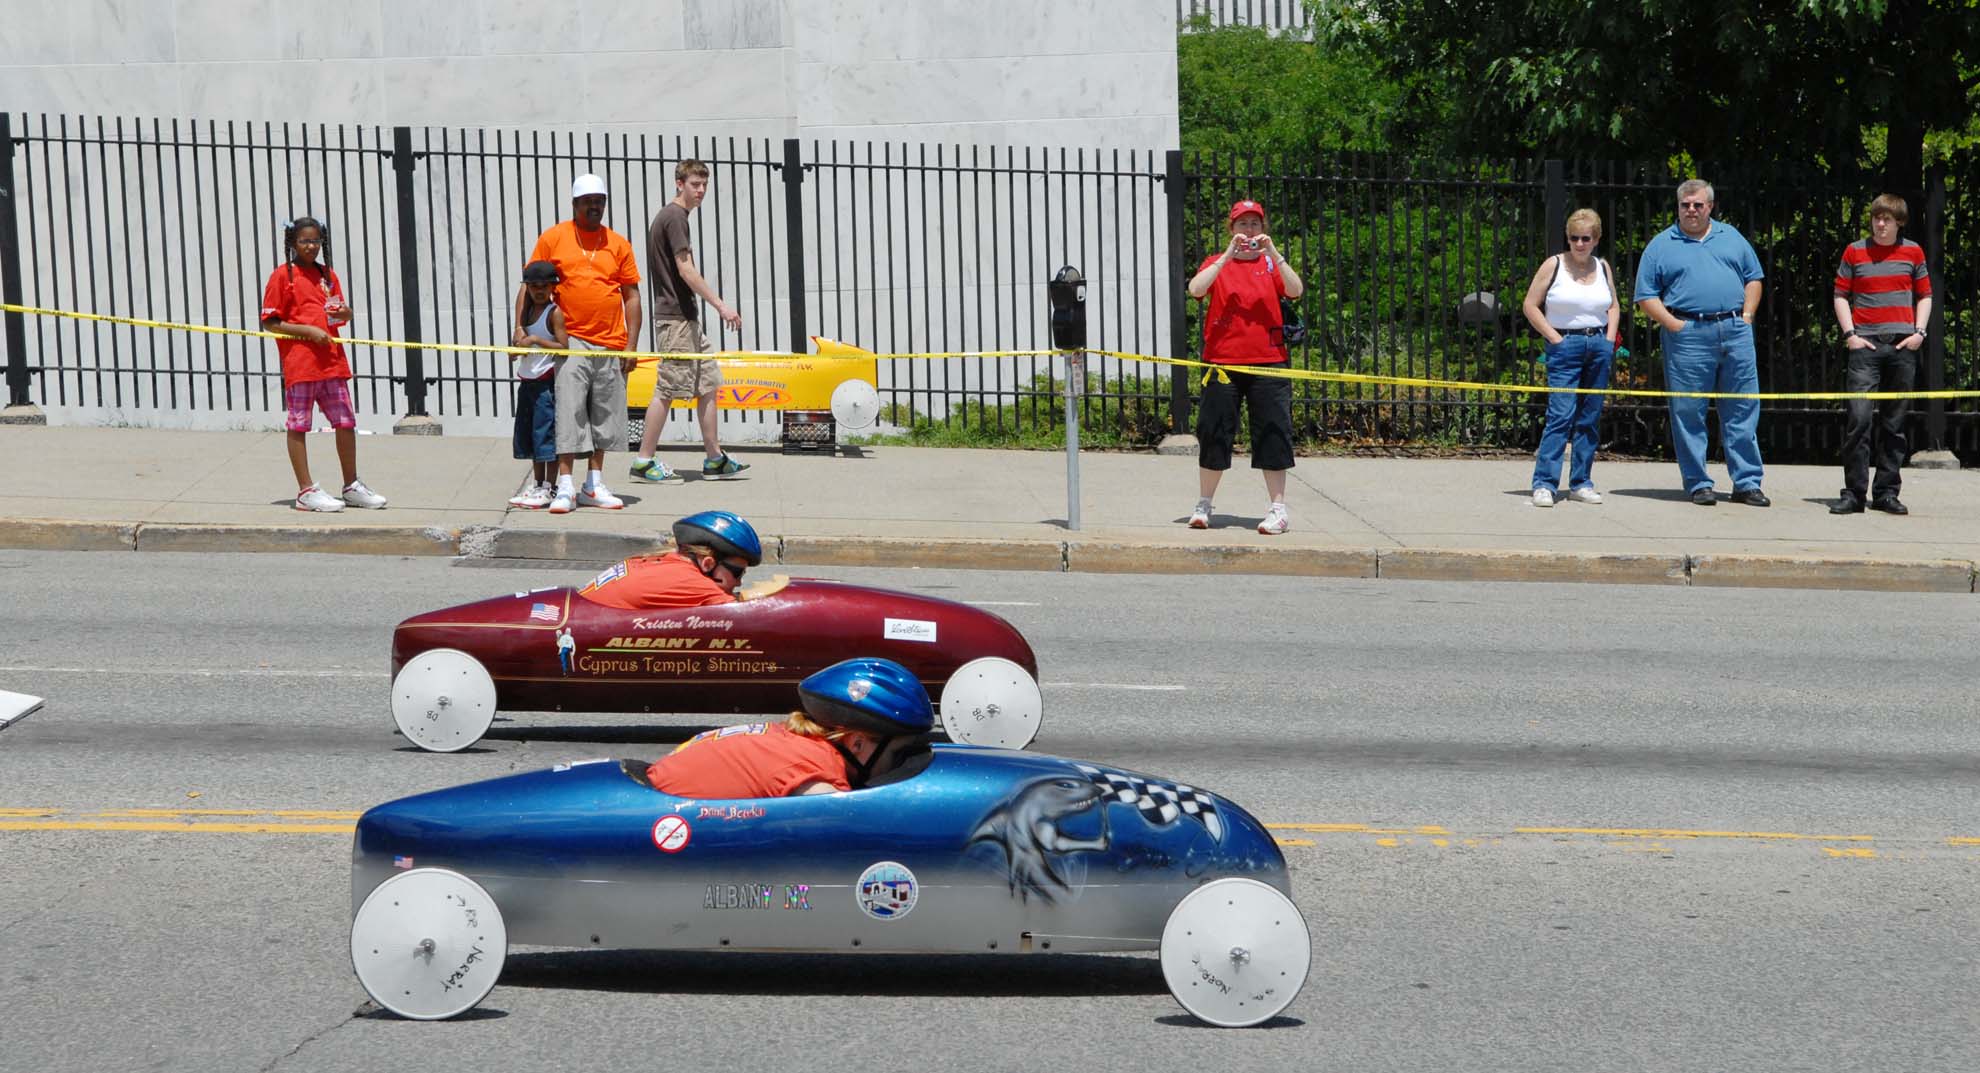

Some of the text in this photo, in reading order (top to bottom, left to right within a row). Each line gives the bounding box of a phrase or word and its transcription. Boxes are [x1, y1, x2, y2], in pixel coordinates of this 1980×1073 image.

[632, 616, 734, 631] Kristen Norray
[605, 637, 752, 649] ALBANY N.Y.
[579, 655, 777, 675] Cyprus Temple Shriners
[702, 884, 773, 910] ALBANY
